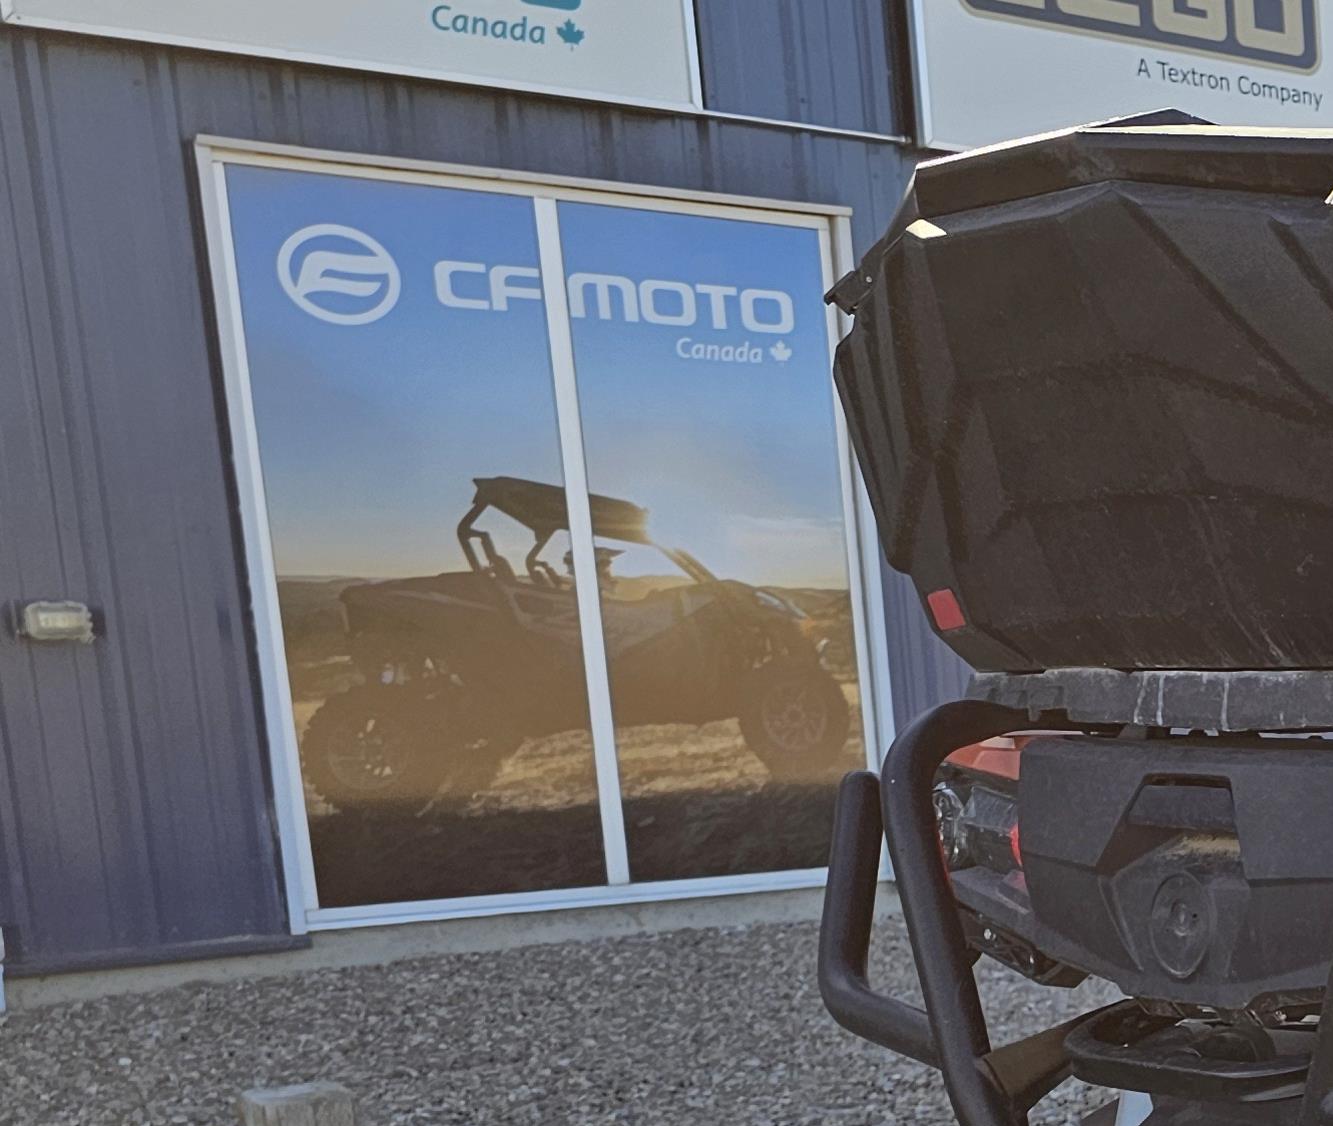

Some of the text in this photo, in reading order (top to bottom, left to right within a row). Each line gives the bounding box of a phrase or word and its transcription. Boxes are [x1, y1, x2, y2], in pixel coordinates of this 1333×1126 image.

[432, 5, 546, 45] Canada
[1137, 58, 1324, 111] A Textron Company
[434, 260, 795, 334] CFMOTO
[675, 337, 763, 364] Canada
